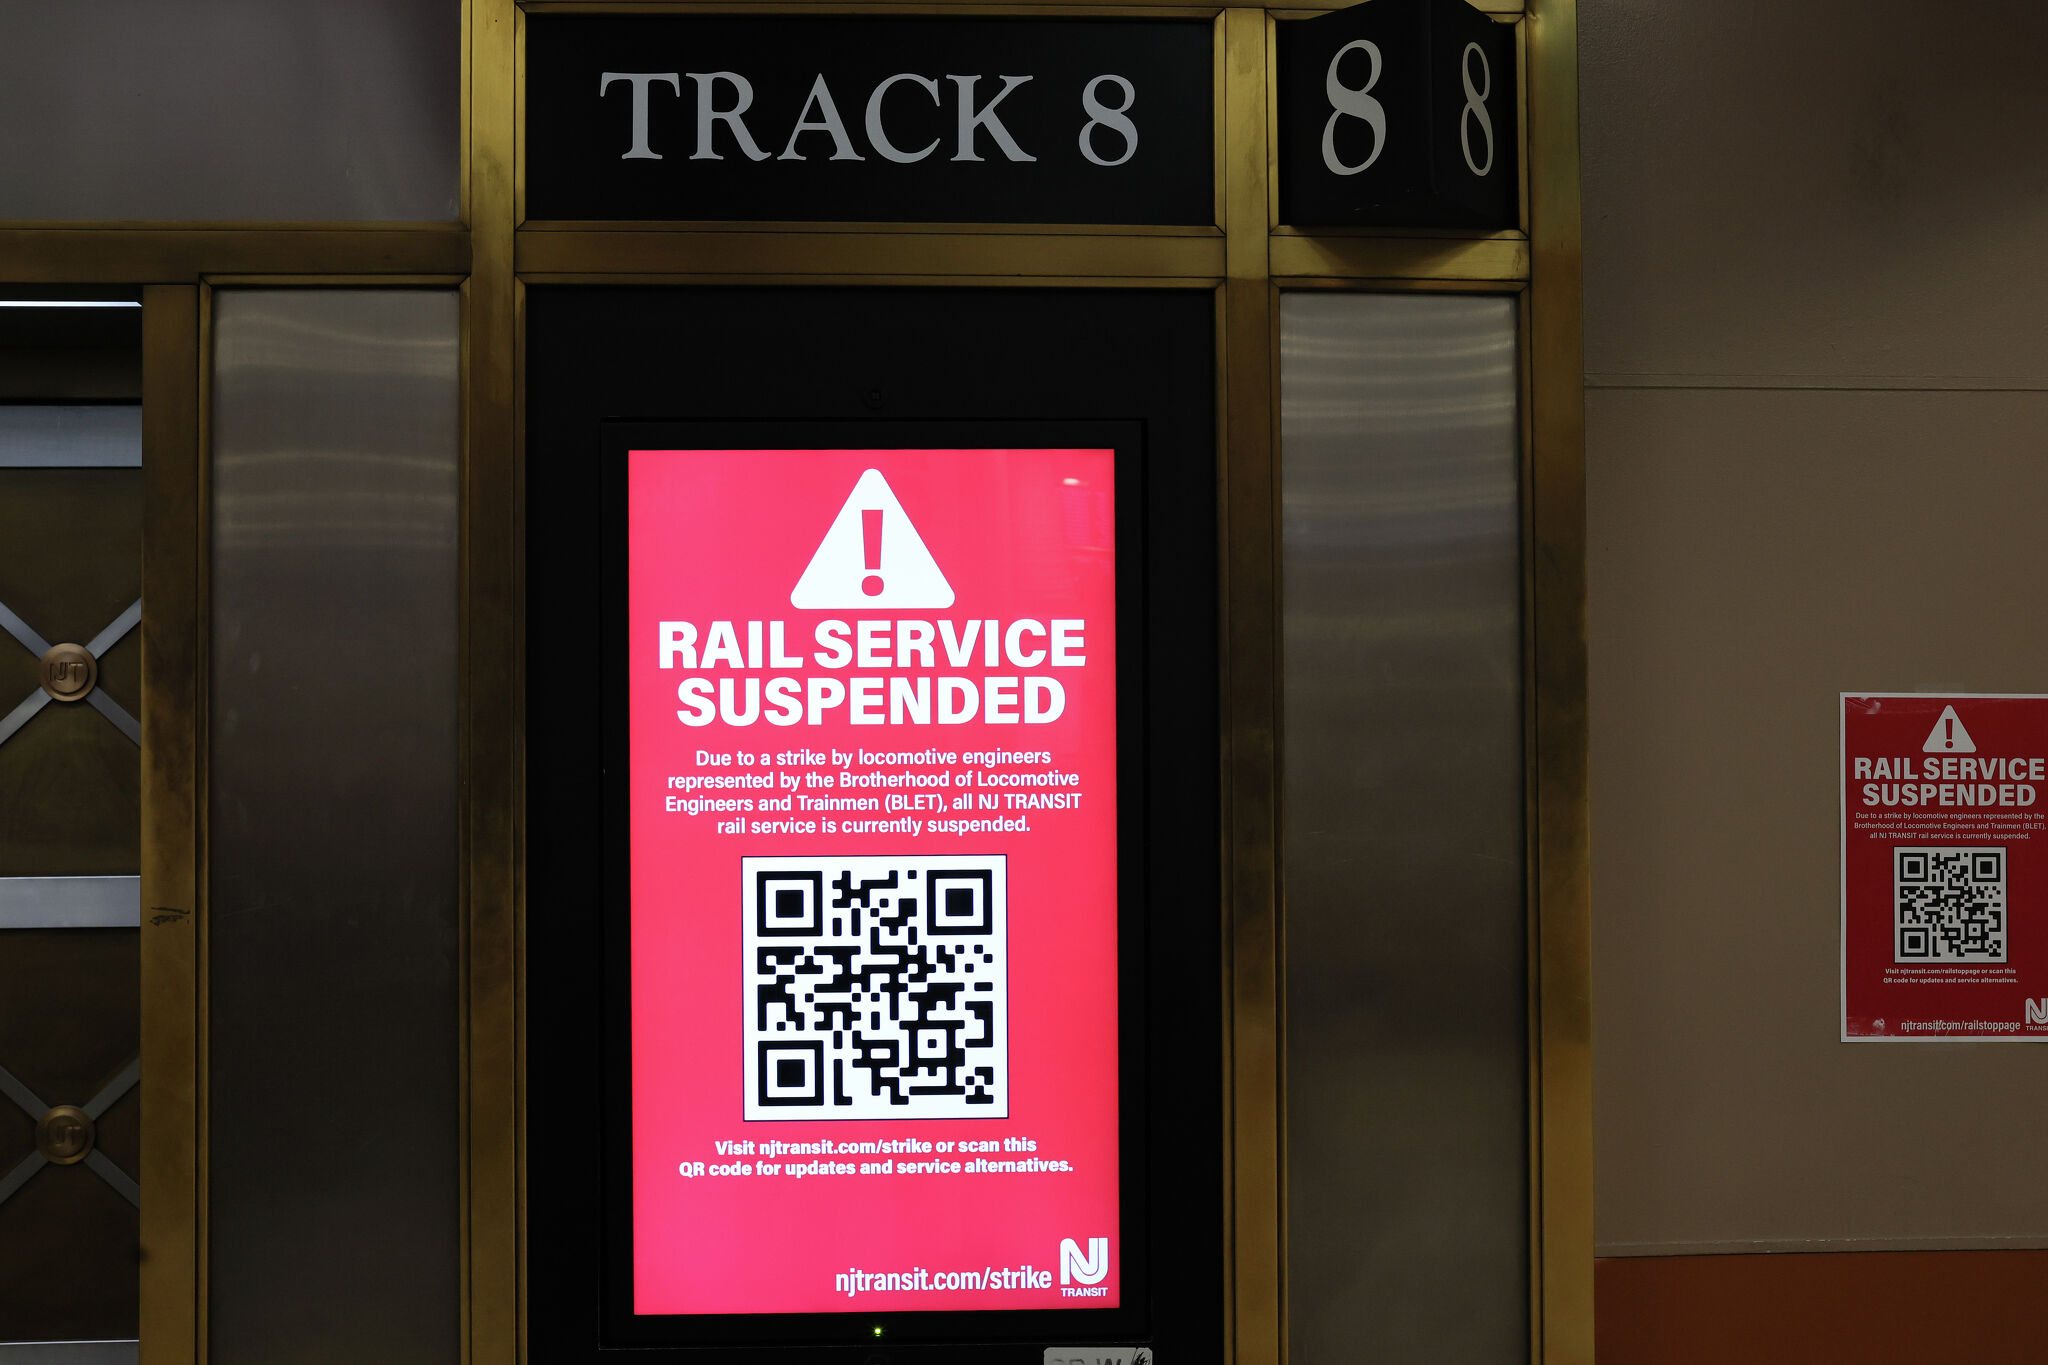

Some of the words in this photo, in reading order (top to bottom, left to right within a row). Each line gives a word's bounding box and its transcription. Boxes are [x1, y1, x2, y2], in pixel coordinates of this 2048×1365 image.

[599, 71, 1038, 164] TRACK
[1078, 74, 1139, 167] 8
[1321, 39, 1387, 176] 8
[1460, 41, 1494, 177] 8
[658, 620, 804, 669] RAIL
[813, 618, 1087, 669] SERVICE
[676, 676, 1066, 727] SUSPENDED
[695, 750, 732, 767] Due
[736, 750, 755, 767] to
[760, 753, 771, 766] a
[776, 748, 827, 766] strike
[831, 748, 854, 770] by
[858, 747, 958, 766] locomotive
[962, 747, 1052, 769] engineers
[1854, 757, 1919, 780] RAIL
[1922, 757, 2046, 781] SERVICE
[667, 771, 774, 792] represented
[779, 771, 801, 792] by
[805, 771, 835, 788] the
[839, 770, 950, 788] Brotherhood
[954, 769, 973, 788] of
[977, 769, 1080, 787] Locomotive
[665, 795, 754, 816] Engineers
[758, 794, 792, 812] and
[796, 794, 879, 812] Trainmen
[884, 793, 948, 814] (BLET),
[952, 792, 973, 810] all
[978, 793, 999, 810] NJ
[1003, 792, 1083, 810] TRANSIT
[1862, 783, 2036, 807] SUSPENDED
[717, 817, 746, 835] rail
[751, 816, 817, 834] service
[821, 816, 837, 834] is
[841, 815, 923, 837] currently
[927, 814, 1031, 837] suspended.
[1854, 821, 1895, 830] Brotherhood
[1895, 821, 1903, 830] of
[1903, 822, 1942, 830] Locomotive
[1942, 822, 1976, 831] Engineers
[1976, 822, 1990, 830] and
[1990, 822, 2021, 830] Trainmen
[1855, 812, 1869, 820] Due
[1870, 812, 1877, 820] to
[1883, 811, 1903, 820] strike
[1903, 812, 1912, 821] by
[1912, 812, 1949, 820] locomotive
[1949, 812, 1982, 821] engineers
[1983, 812, 2023, 821] represented
[2023, 812, 2033, 821] by
[2033, 812, 2045, 820] the
[1869, 831, 1878, 840] all
[1879, 832, 1887, 840] NJ
[1888, 831, 1918, 840] TRANSIT
[1918, 831, 1929, 840] rail
[1930, 832, 1954, 840] service
[1955, 832, 1962, 840] is
[1962, 832, 1992, 841] currently
[1992, 832, 2031, 841] suspended.
[1900, 968, 1980, 976] njtransit.com/railstoppage
[1919, 977, 1944, 985] updates
[1980, 976, 2019, 984] alternatives.
[714, 1139, 756, 1156] Visit
[759, 1138, 933, 1159] njtransit.com/strike
[935, 1140, 956, 1154] or
[957, 1140, 1000, 1154] scan
[1003, 1136, 1039, 1153] this
[678, 1161, 706, 1179] QR
[708, 1160, 753, 1177] code
[755, 1160, 782, 1176] for
[785, 1159, 857, 1179] updates
[859, 1158, 893, 1175] and
[896, 1158, 962, 1175] service
[964, 1156, 1074, 1174] alternatives.
[1060, 1237, 1109, 1285] NJ
[835, 1265, 1053, 1298] njtransit.com/strike
[1060, 1287, 1108, 1297] TRANSIT
